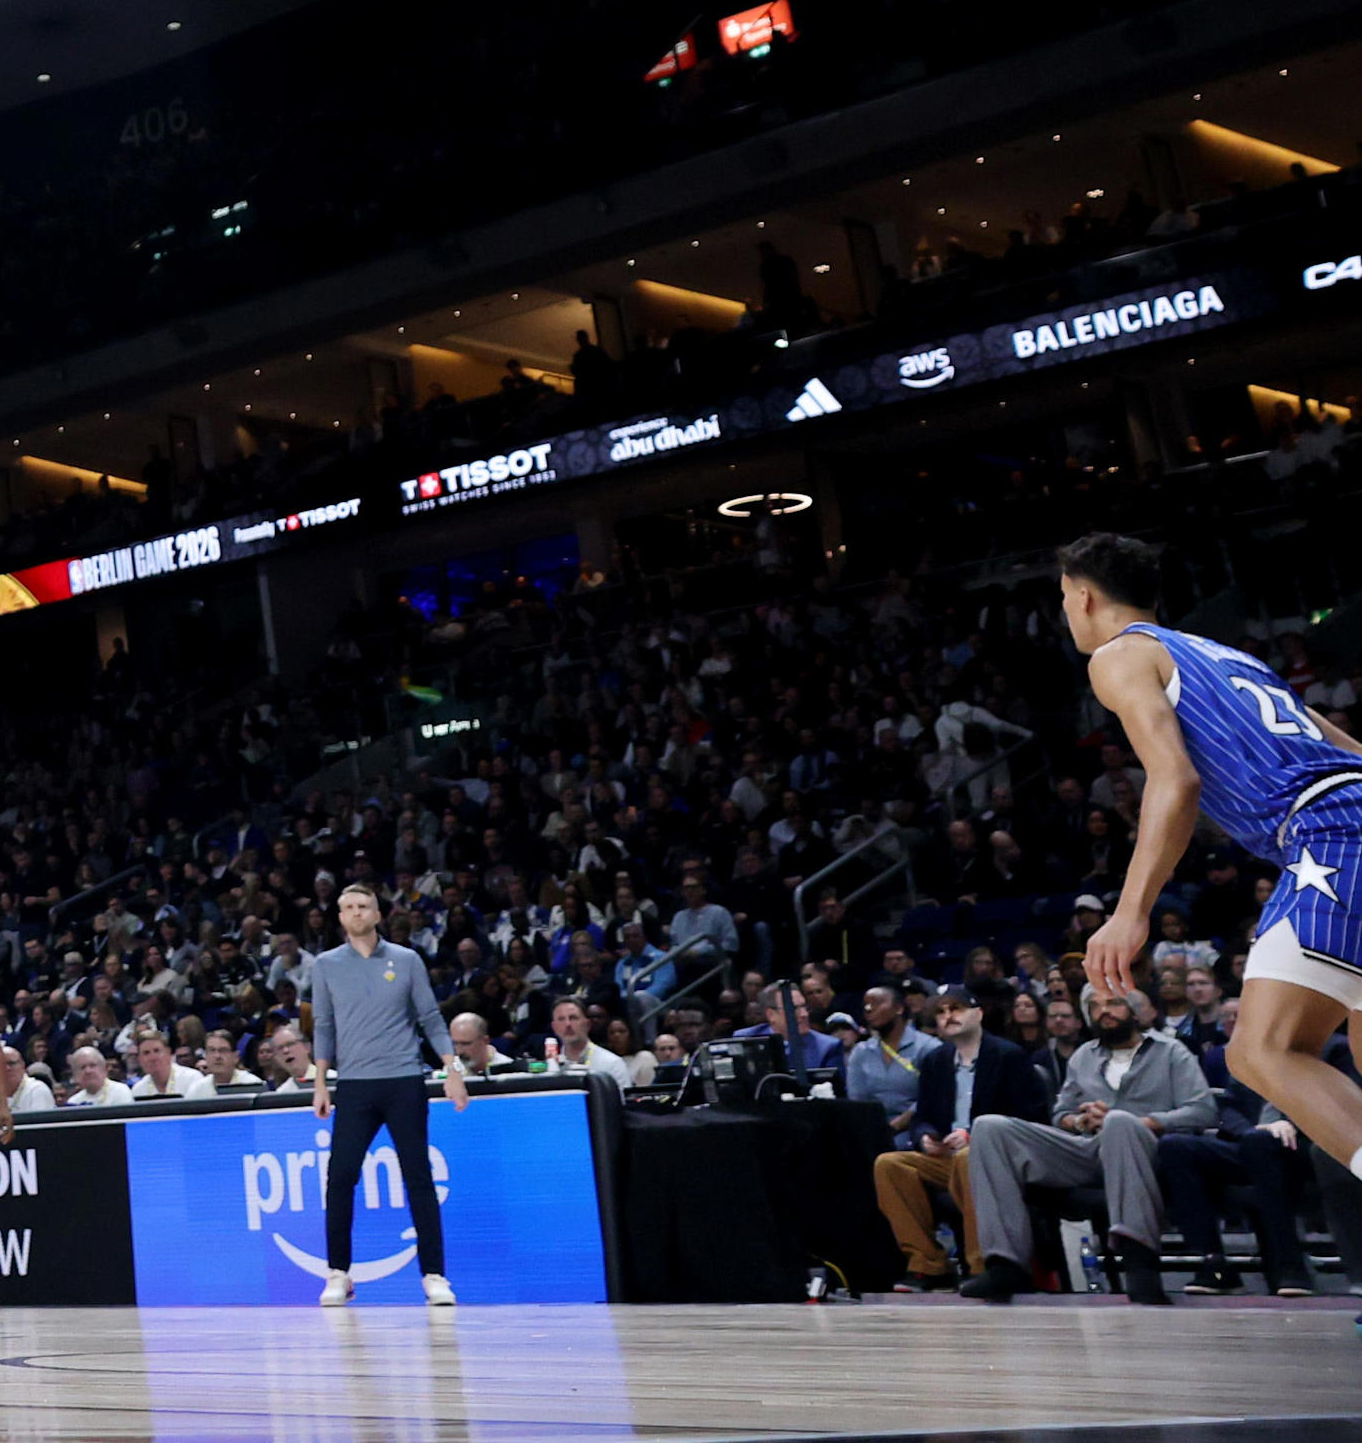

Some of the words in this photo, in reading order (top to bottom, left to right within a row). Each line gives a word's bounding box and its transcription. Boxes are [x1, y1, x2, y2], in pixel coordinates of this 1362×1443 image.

[119, 99, 189, 148] 406
[1012, 285, 1225, 358] BALENCIAGA
[898, 347, 951, 378] aws
[610, 434, 655, 462] abu
[655, 415, 721, 453] dhabi
[439, 444, 552, 493] TISSOT
[492, 477, 526, 494] SINCE
[298, 498, 361, 528] TISSOT
[82, 547, 135, 590] BERLIN
[134, 537, 177, 578] GAME
[176, 526, 221, 569] 2026
